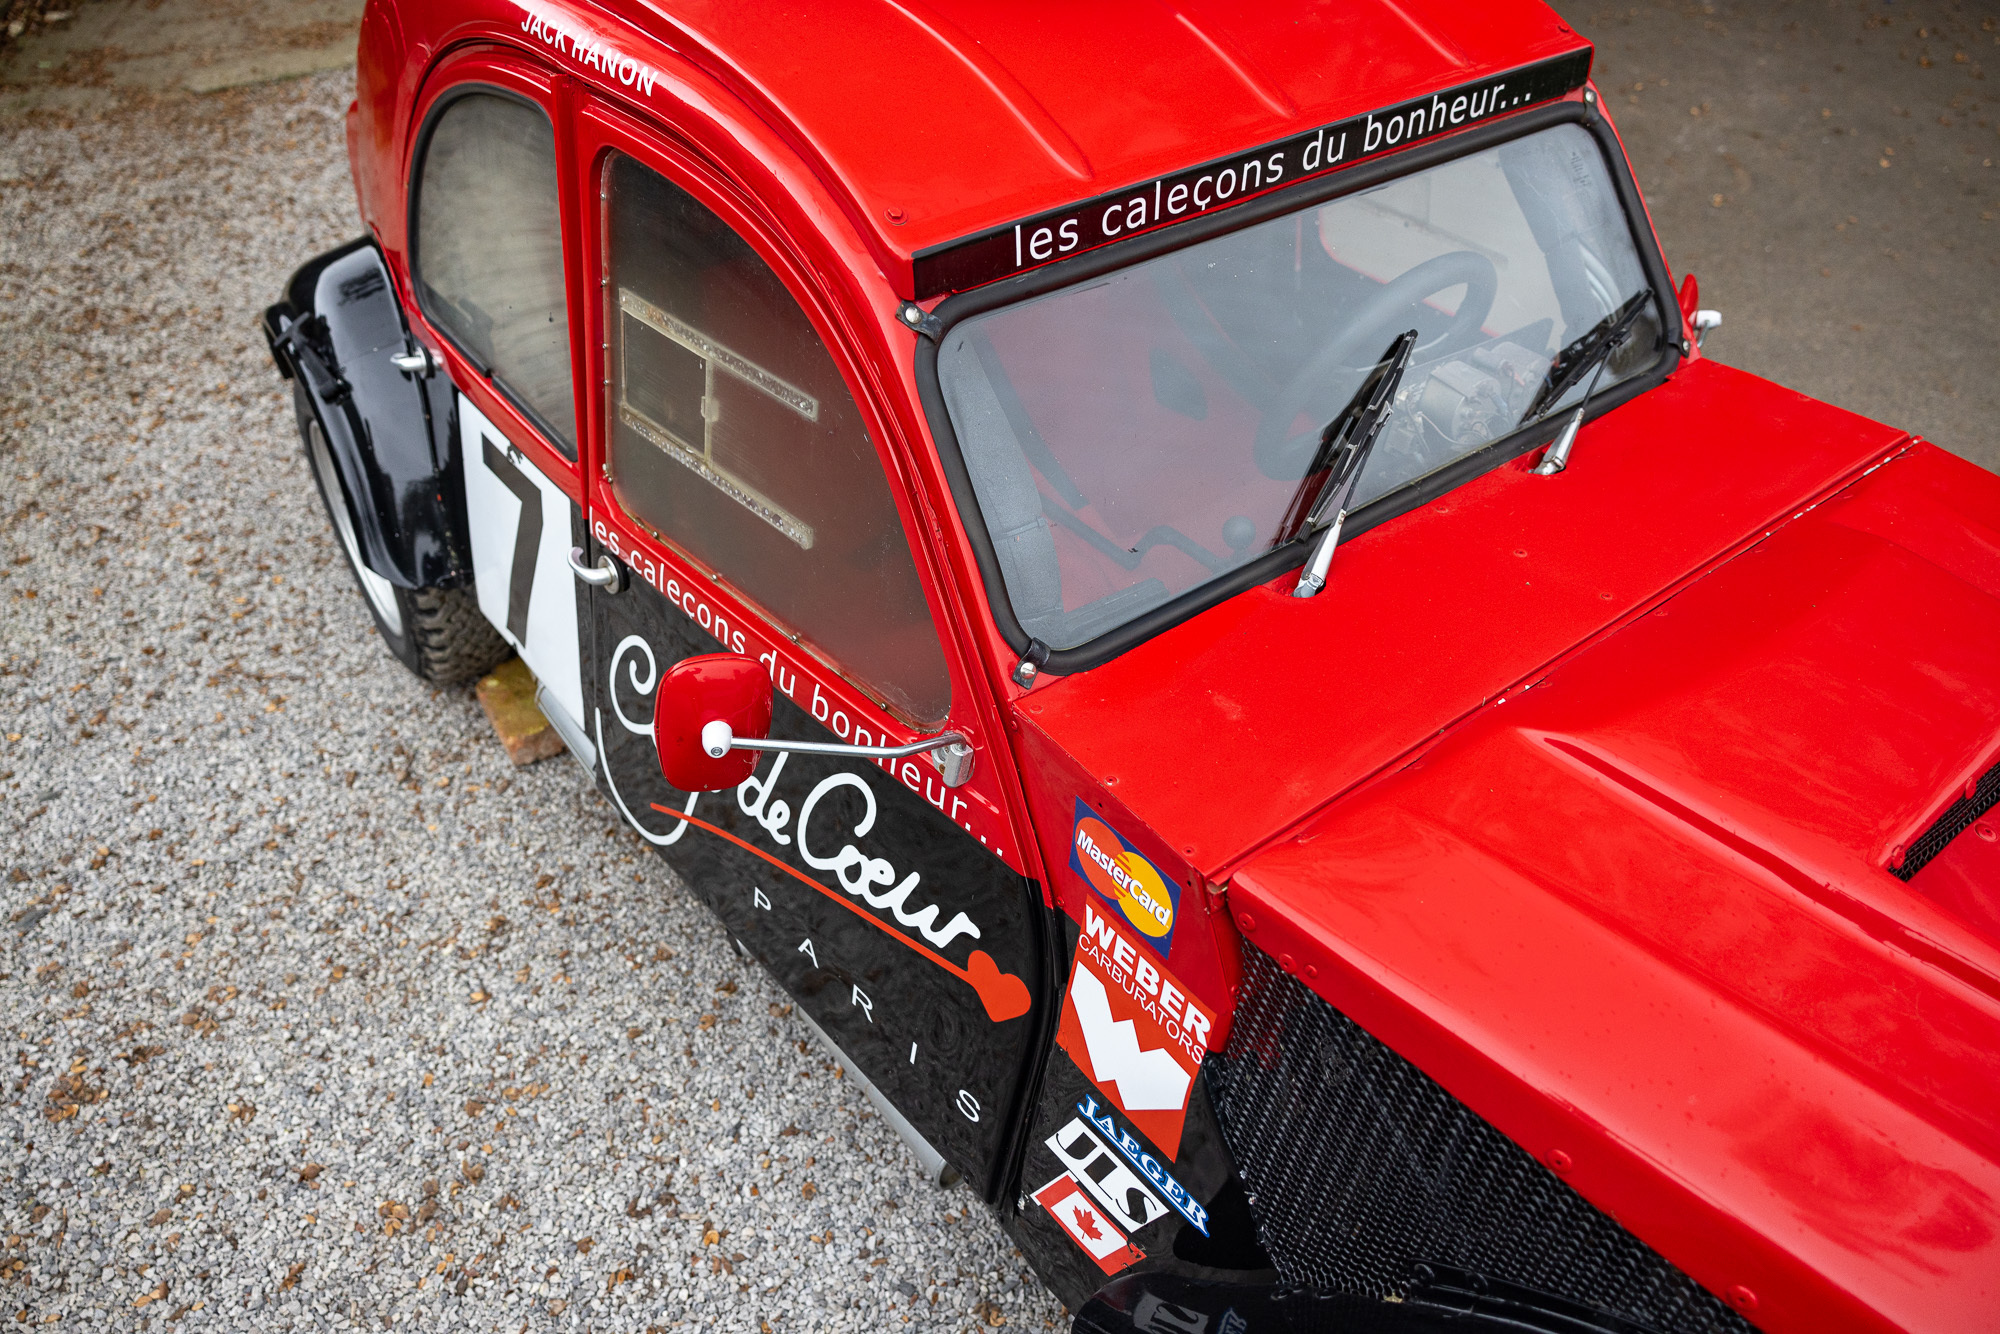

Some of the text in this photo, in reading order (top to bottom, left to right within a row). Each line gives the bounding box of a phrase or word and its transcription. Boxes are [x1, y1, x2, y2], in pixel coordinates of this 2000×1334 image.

[521, 11, 659, 97] JACK HANON
[1013, 83, 1532, 267] les caleçons du bonheur...
[481, 432, 543, 650] 7
[589, 506, 621, 556] les
[630, 550, 746, 655] caleçons
[759, 650, 796, 698] du
[736, 751, 791, 846] de
[1076, 829, 1171, 927] MasterCard
[1078, 934, 1204, 1066] CARBURATORS
[1085, 903, 1212, 1049] WEBER
[1077, 1094, 1210, 1238] JAEGER
